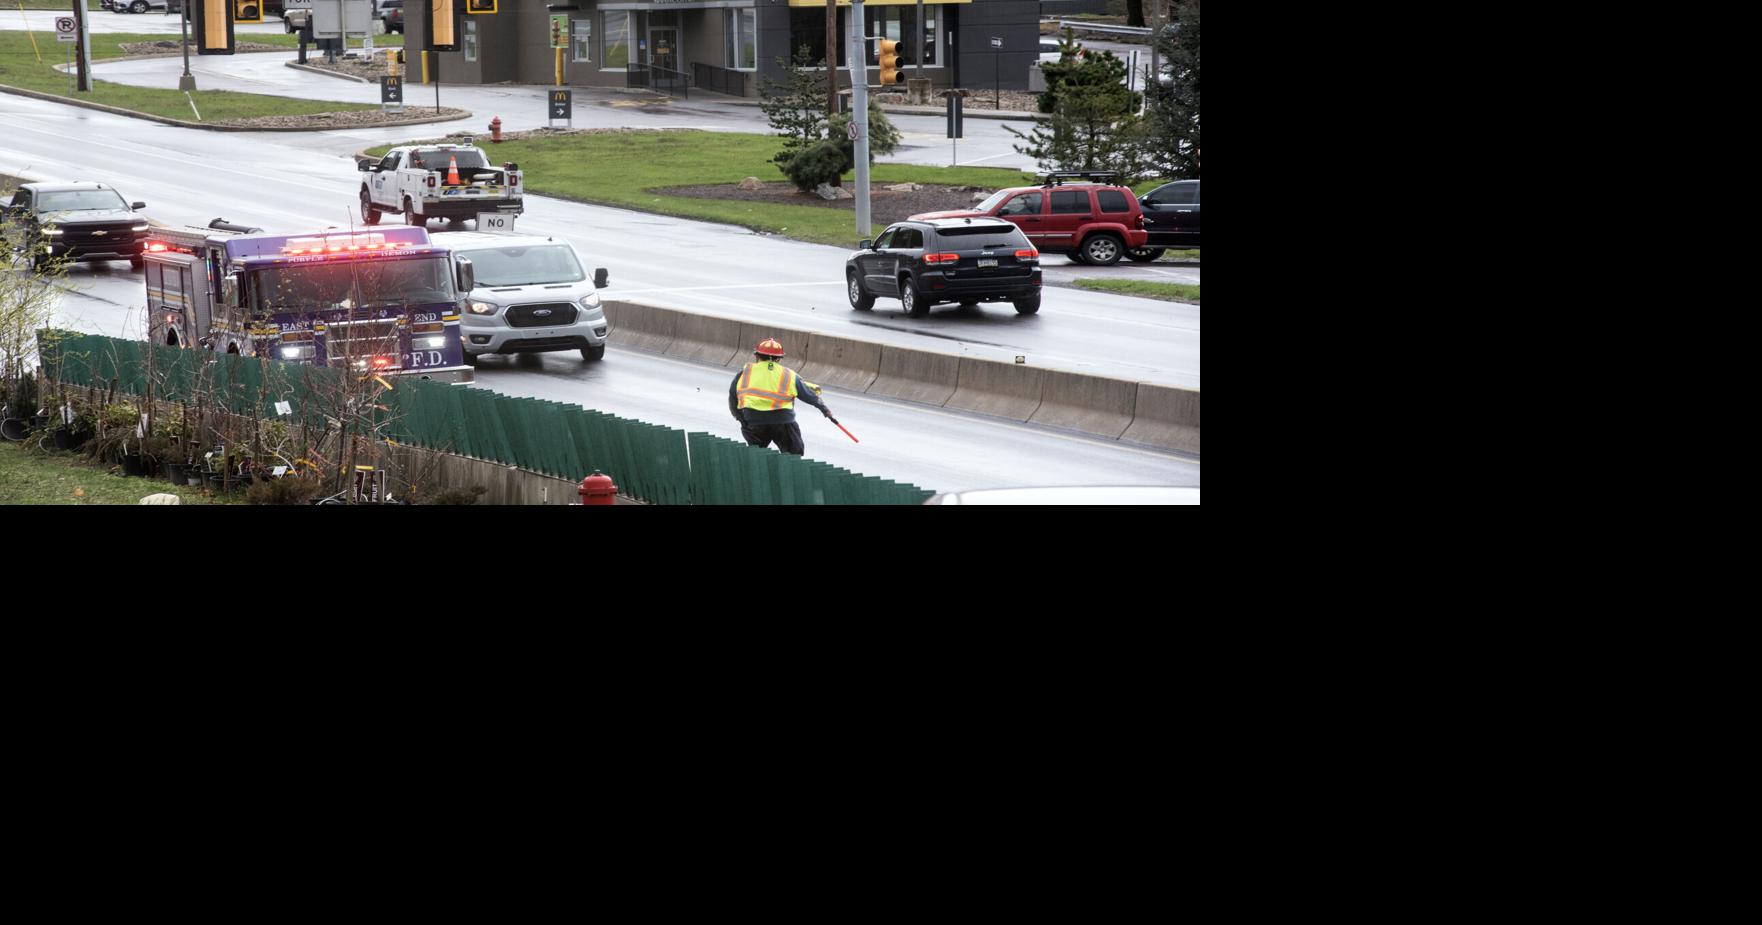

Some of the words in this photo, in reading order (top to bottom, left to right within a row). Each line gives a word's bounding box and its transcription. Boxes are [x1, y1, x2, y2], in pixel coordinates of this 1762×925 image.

[487, 218, 504, 228] NO
[381, 249, 416, 257] DEMON
[282, 321, 309, 332] EAST
